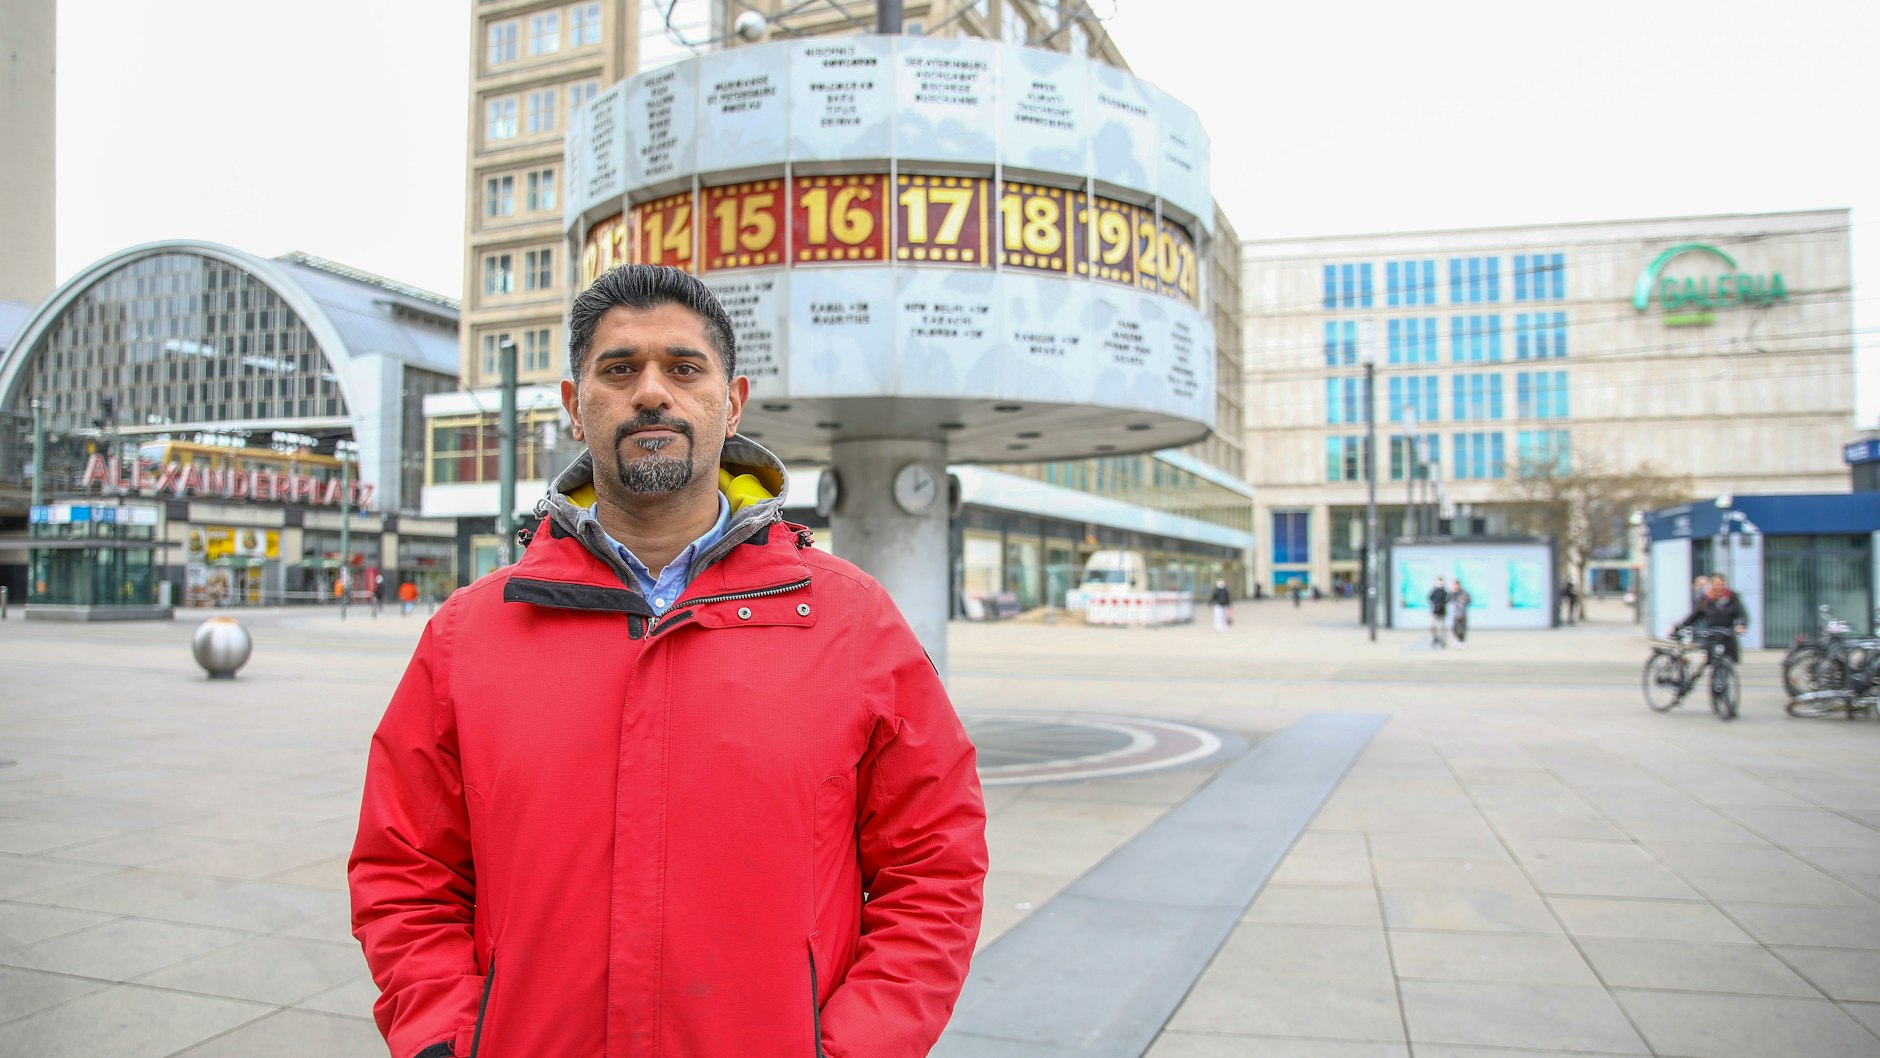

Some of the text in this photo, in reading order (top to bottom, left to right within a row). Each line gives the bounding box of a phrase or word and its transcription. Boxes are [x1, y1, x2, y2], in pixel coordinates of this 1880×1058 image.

[644, 205, 691, 265] 14
[713, 193, 776, 254] 15
[801, 186, 874, 245] 16
[899, 186, 974, 245] 17
[1001, 194, 1062, 255] 18
[1078, 207, 1131, 265] 19
[1139, 222, 1177, 284] 20
[1660, 273, 1790, 309] GALERIA
[83, 454, 375, 506] ALEXANDERPLATZ
